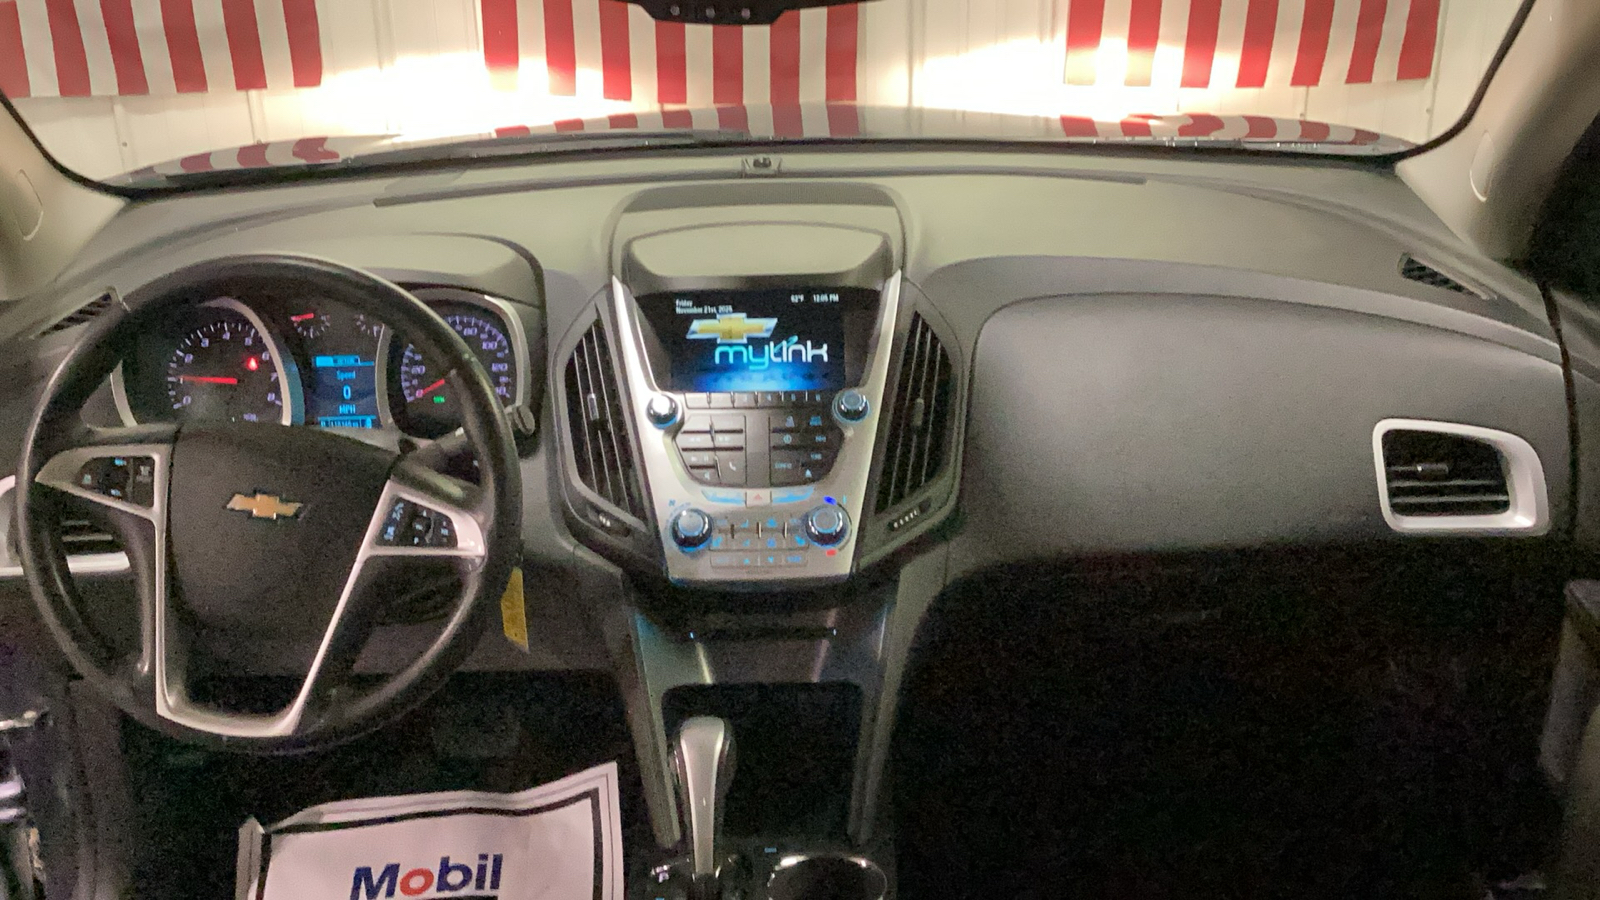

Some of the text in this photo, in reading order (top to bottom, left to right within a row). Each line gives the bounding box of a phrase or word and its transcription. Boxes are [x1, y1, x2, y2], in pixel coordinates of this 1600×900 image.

[829, 293, 839, 303] PM
[343, 385, 352, 400] 0
[339, 404, 356, 415] MPH
[350, 853, 503, 900] Mobil
